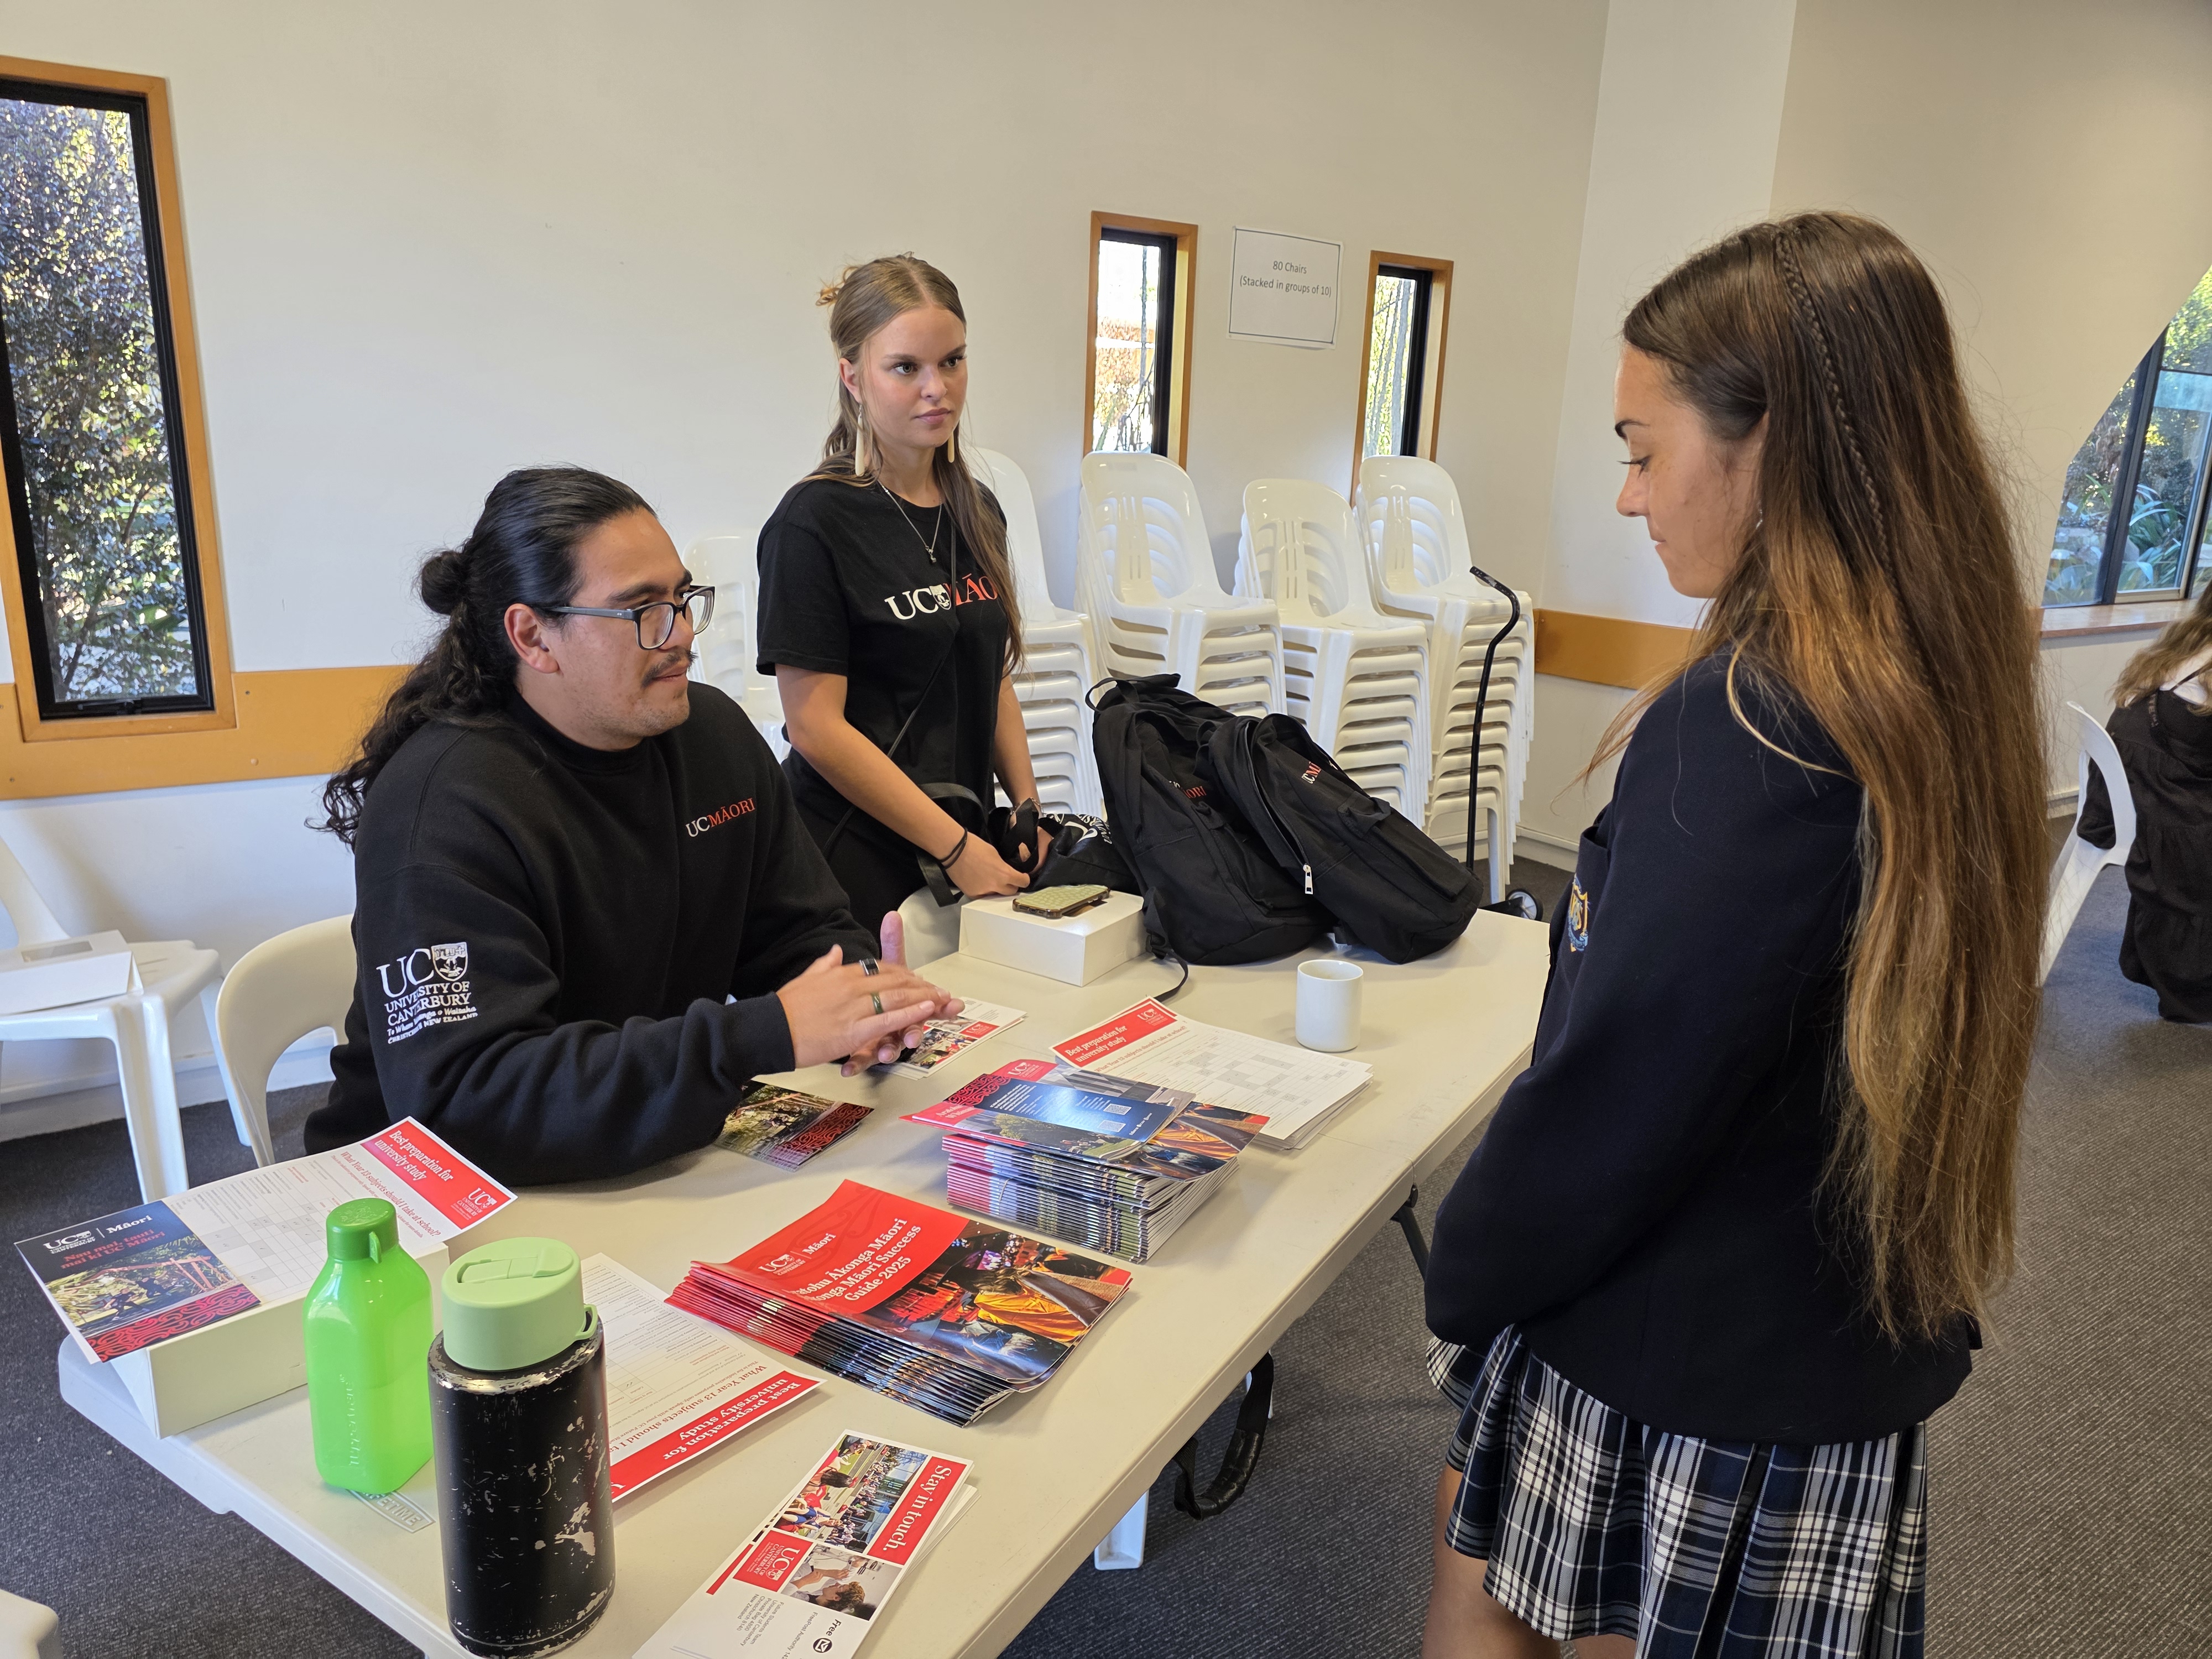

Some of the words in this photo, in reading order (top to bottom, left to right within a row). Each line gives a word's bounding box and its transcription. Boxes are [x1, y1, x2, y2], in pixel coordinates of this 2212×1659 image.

[1272, 260, 1283, 270] 80
[1285, 262, 1307, 274] Chairs
[1240, 275, 1274, 289] (Stacked
[1276, 279, 1284, 290] in
[1285, 283, 1310, 295] groups
[1312, 285, 1319, 294] of
[1321, 286, 1332, 298] 10)
[376, 948, 434, 998] UC
[384, 983, 450, 1013] UNIVERSITY
[451, 981, 470, 993] OF
[388, 992, 471, 1026] CANTERBURY
[1065, 1046, 1083, 1056] Best
[1081, 1031, 1119, 1050] preparation
[1075, 1045, 1109, 1062] university
[1107, 1037, 1126, 1047] study
[374, 1140, 409, 1166] university
[404, 1164, 426, 1181] study
[389, 1130, 410, 1145] Best
[400, 1142, 442, 1173] preparation
[438, 1170, 453, 1181] for
[341, 1151, 356, 1163] What
[352, 1162, 364, 1171] Year
[366, 1176, 387, 1192] subjects
[383, 1191, 405, 1205] should
[401, 1206, 415, 1216] take
[417, 1220, 441, 1236] school?
[468, 1187, 492, 1206] UC
[43, 1234, 79, 1250] UC
[106, 1215, 153, 1234] Māori
[103, 1245, 125, 1255] UC
[758, 1259, 787, 1272] UC
[802, 1233, 836, 1255] Māori
[825, 1245, 875, 1281] Ākonga
[868, 1218, 907, 1250] Māori
[842, 1261, 881, 1288] Māori
[875, 1225, 922, 1264] Success
[844, 1277, 883, 1301] Guide
[879, 1256, 911, 1280] 2025
[739, 1366, 766, 1380] What
[717, 1380, 739, 1393] Year
[721, 1379, 788, 1417] university
[768, 1383, 801, 1400] Best
[662, 1399, 703, 1422] subjects
[685, 1399, 766, 1445] preparation
[626, 1422, 661, 1443] should
[680, 1417, 718, 1440] study
[663, 1446, 687, 1459] for
[920, 1465, 952, 1495] Stay
[911, 1495, 933, 1509] in
[883, 1511, 922, 1551] touch.
[754, 1543, 779, 1574] CANTERBURY
[765, 1546, 785, 1571] UNIVERSITY
[773, 1547, 801, 1571] UC
[744, 1596, 765, 1620] Christchurch
[750, 1594, 759, 1603] New
[759, 1598, 772, 1611] Private
[760, 1600, 778, 1619] University
[772, 1601, 784, 1615] Future
[737, 1603, 753, 1619] Zealand
[751, 1611, 761, 1620] Bag
[801, 1611, 818, 1631] FreePost
[736, 1620, 747, 1631] 8140
[744, 1620, 754, 1631] 4800
[759, 1615, 775, 1632] Students
[826, 1619, 842, 1636] Free
[740, 1624, 760, 1647] Canterbury
[750, 1634, 762, 1645] Team
[787, 1631, 804, 1651] Authority
